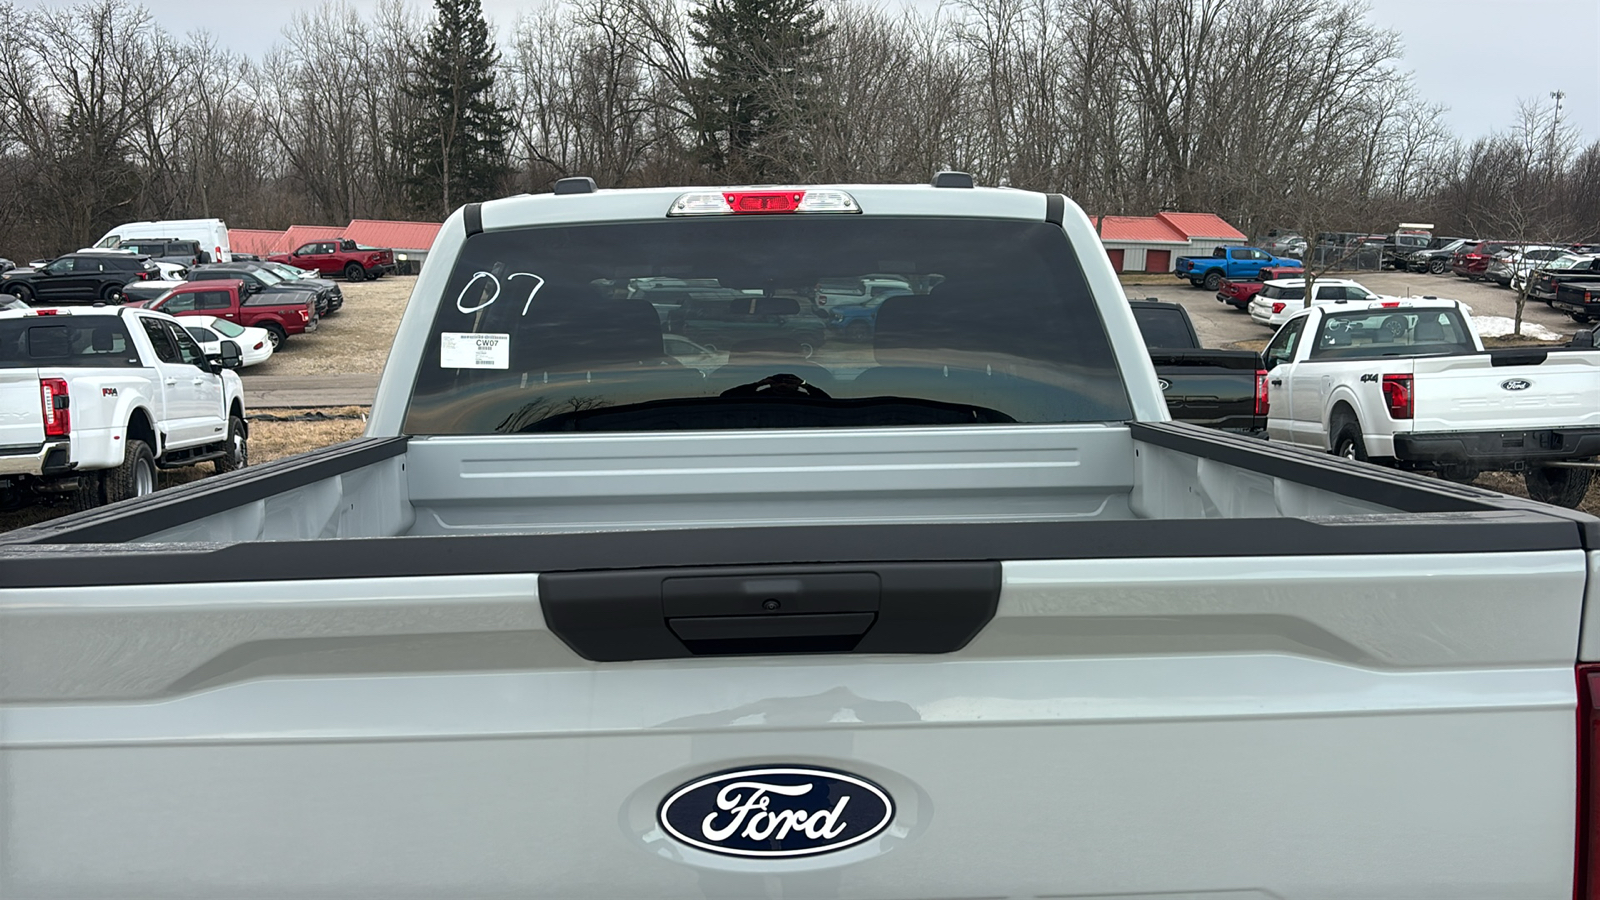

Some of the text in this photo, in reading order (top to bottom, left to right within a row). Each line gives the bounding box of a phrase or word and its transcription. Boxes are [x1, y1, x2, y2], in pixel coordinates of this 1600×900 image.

[456, 271, 545, 316] 07
[475, 339, 499, 347] CW07
[1506, 379, 1527, 390] Ford
[701, 781, 851, 842] Ford
